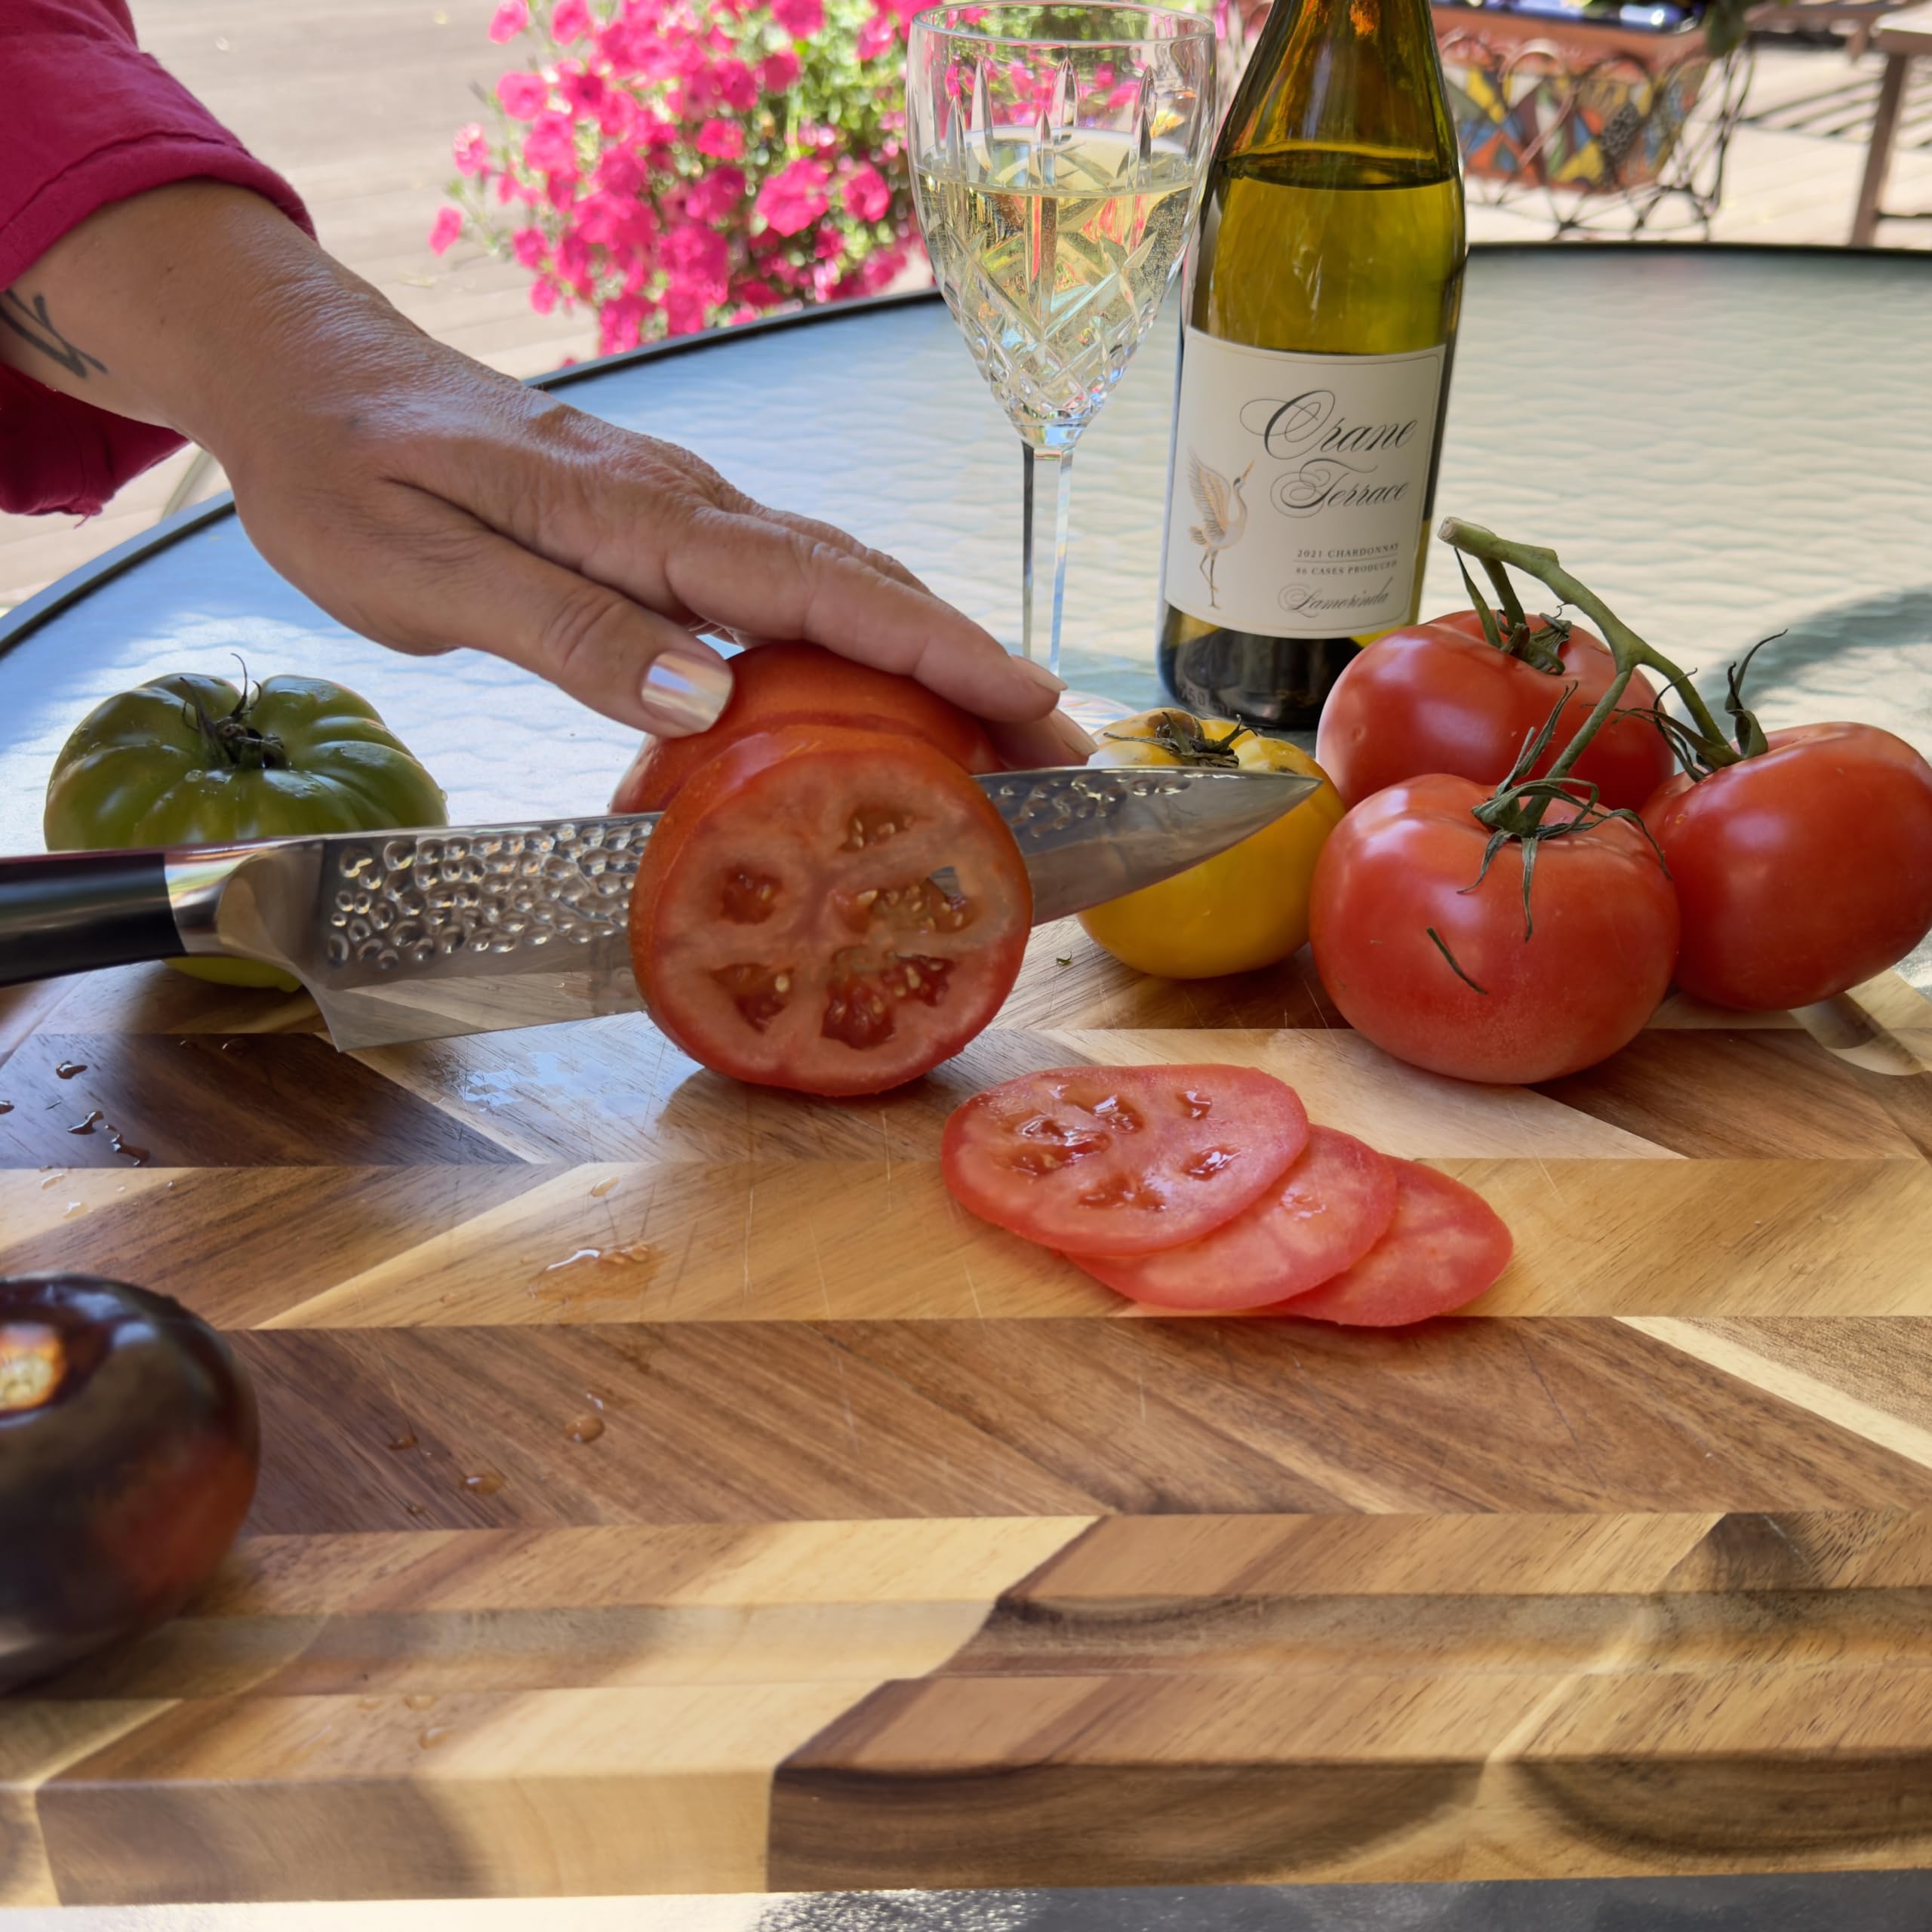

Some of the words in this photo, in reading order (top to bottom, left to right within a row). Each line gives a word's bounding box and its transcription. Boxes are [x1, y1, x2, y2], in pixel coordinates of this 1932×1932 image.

[1239, 389, 1418, 460] Crane
[1270, 458, 1410, 518] Terrace
[1297, 549, 1322, 558] 2021
[1327, 542, 1399, 558] CHARDONNAY
[1311, 567, 1344, 575] CASES
[1348, 559, 1397, 574] PRODUCED
